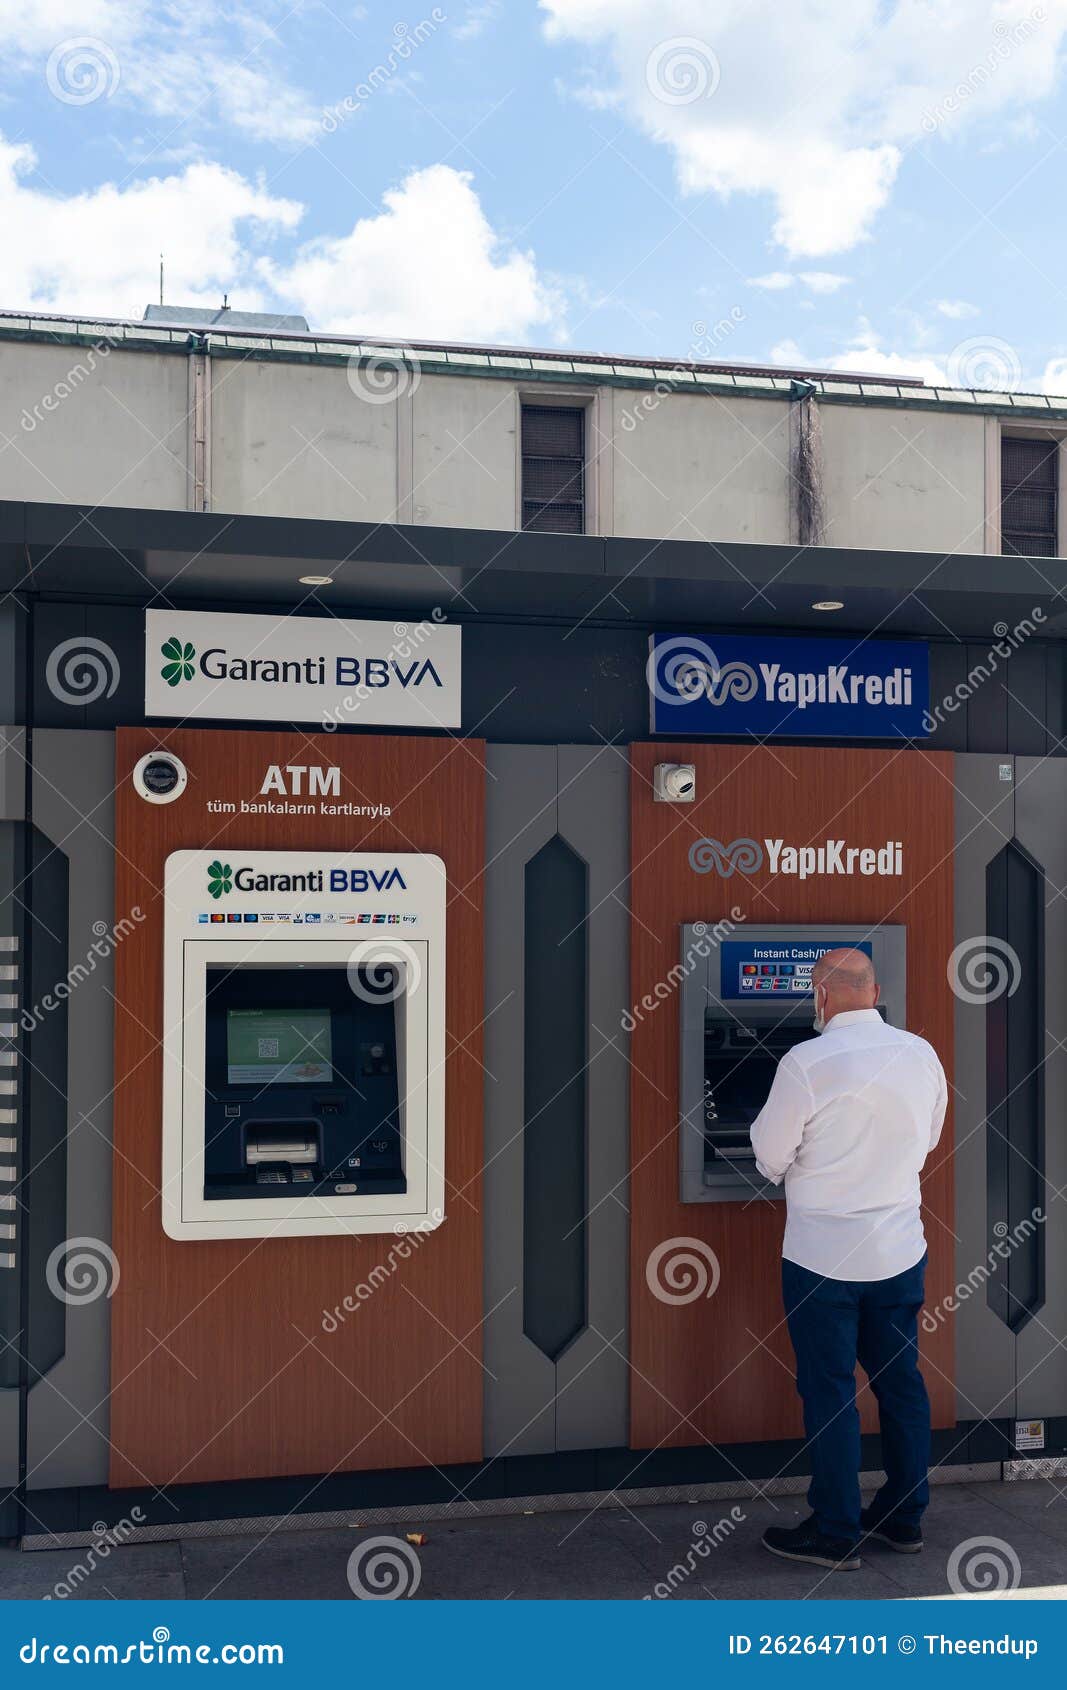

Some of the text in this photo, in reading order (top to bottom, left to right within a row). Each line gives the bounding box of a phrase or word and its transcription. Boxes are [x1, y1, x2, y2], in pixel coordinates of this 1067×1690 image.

[200, 648, 442, 688] Garanti BBVA
[759, 663, 912, 708] YapıKredi
[260, 765, 341, 796] ATM
[206, 800, 391, 819] tüm bankaların kartlarıyla
[764, 838, 903, 879] YapıKredi
[234, 867, 407, 892] Garanti BBVA
[754, 948, 789, 959] Instant
[793, 979, 812, 990] troy
